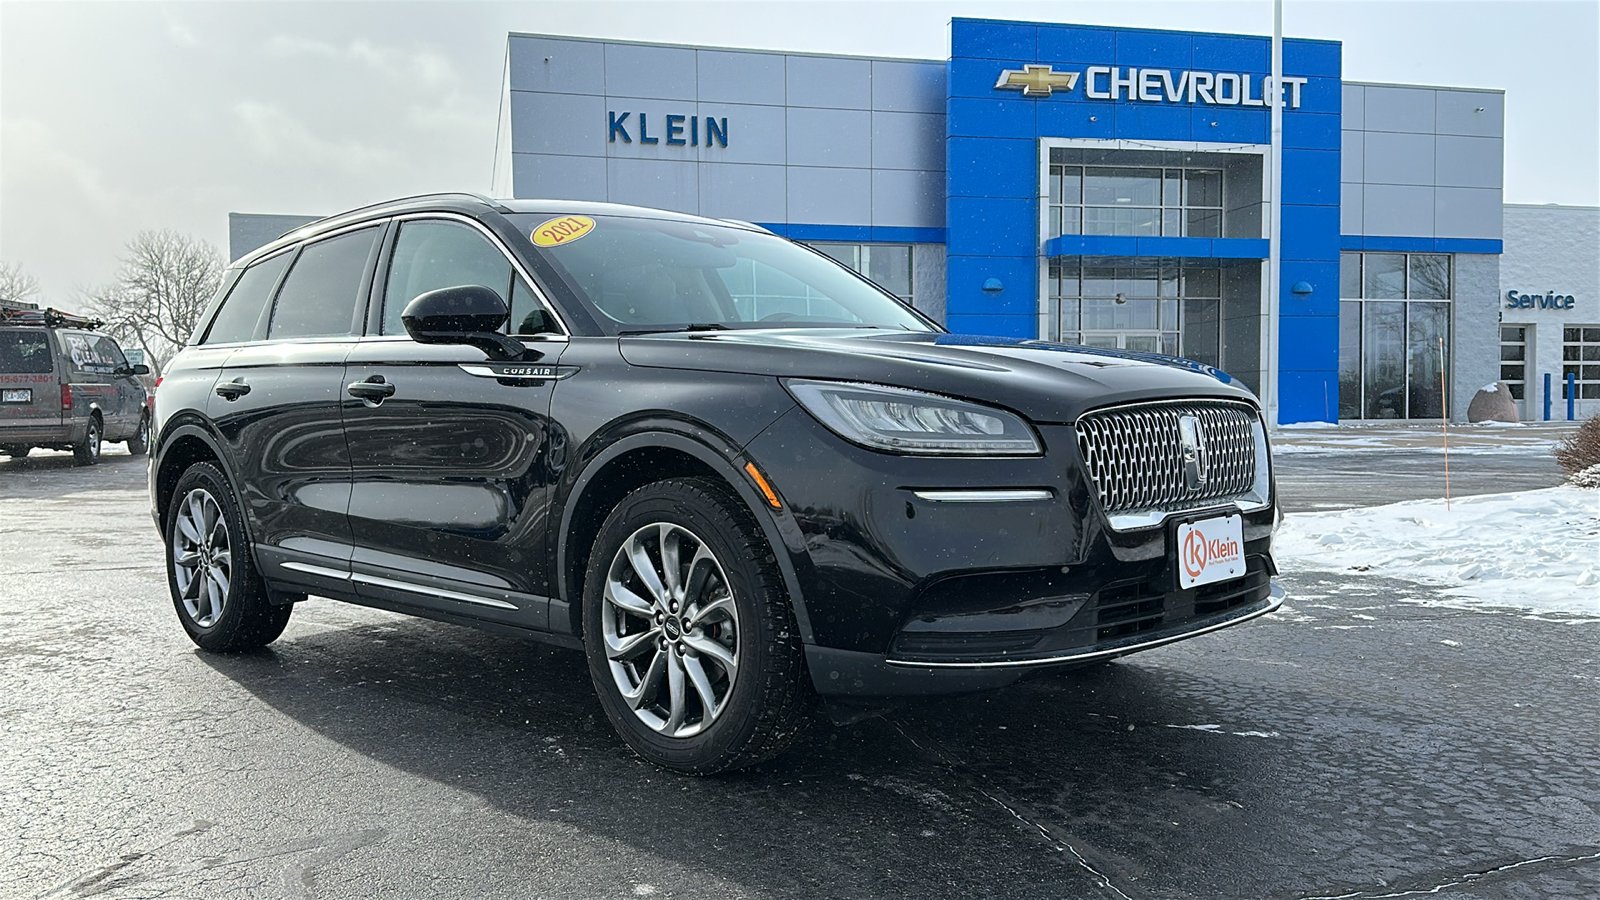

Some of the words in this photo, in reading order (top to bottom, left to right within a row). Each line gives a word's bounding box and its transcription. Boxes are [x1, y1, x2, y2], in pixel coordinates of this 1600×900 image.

[1086, 66, 1308, 108] CHEVROLET
[608, 111, 728, 148] KLEIN
[542, 217, 588, 242] 2021
[1506, 290, 1575, 309] Service
[1209, 537, 1238, 560] Klein
